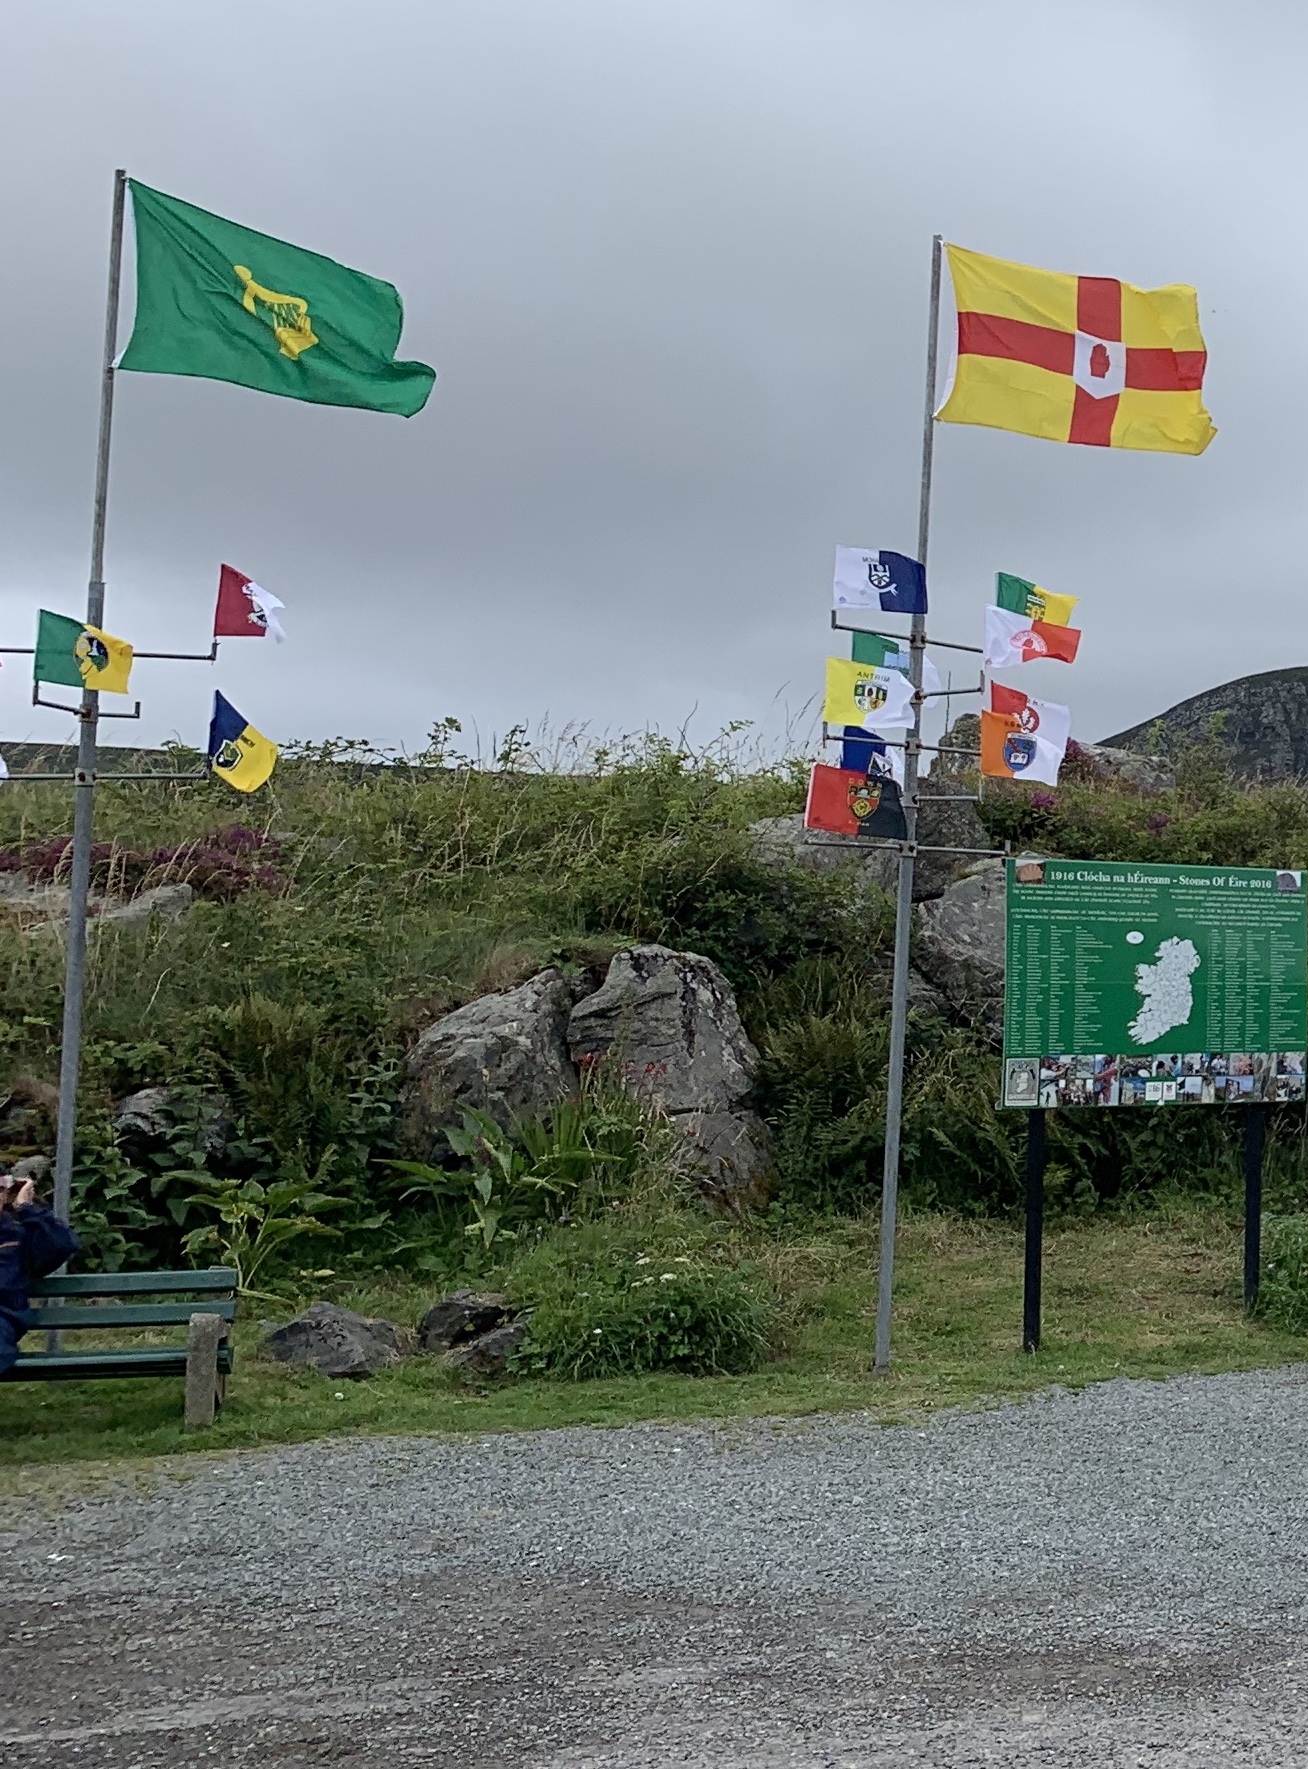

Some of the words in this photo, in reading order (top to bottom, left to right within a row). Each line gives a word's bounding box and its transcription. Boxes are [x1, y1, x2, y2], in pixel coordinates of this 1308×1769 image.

[1050, 871, 1075, 880] 1916
[1077, 871, 1110, 882] Clócha
[1127, 871, 1170, 884] hÉireann
[1179, 875, 1210, 886] Stones
[1213, 876, 1225, 886] Of
[1228, 875, 1247, 887] Éire
[1250, 880, 1272, 888] 2016
